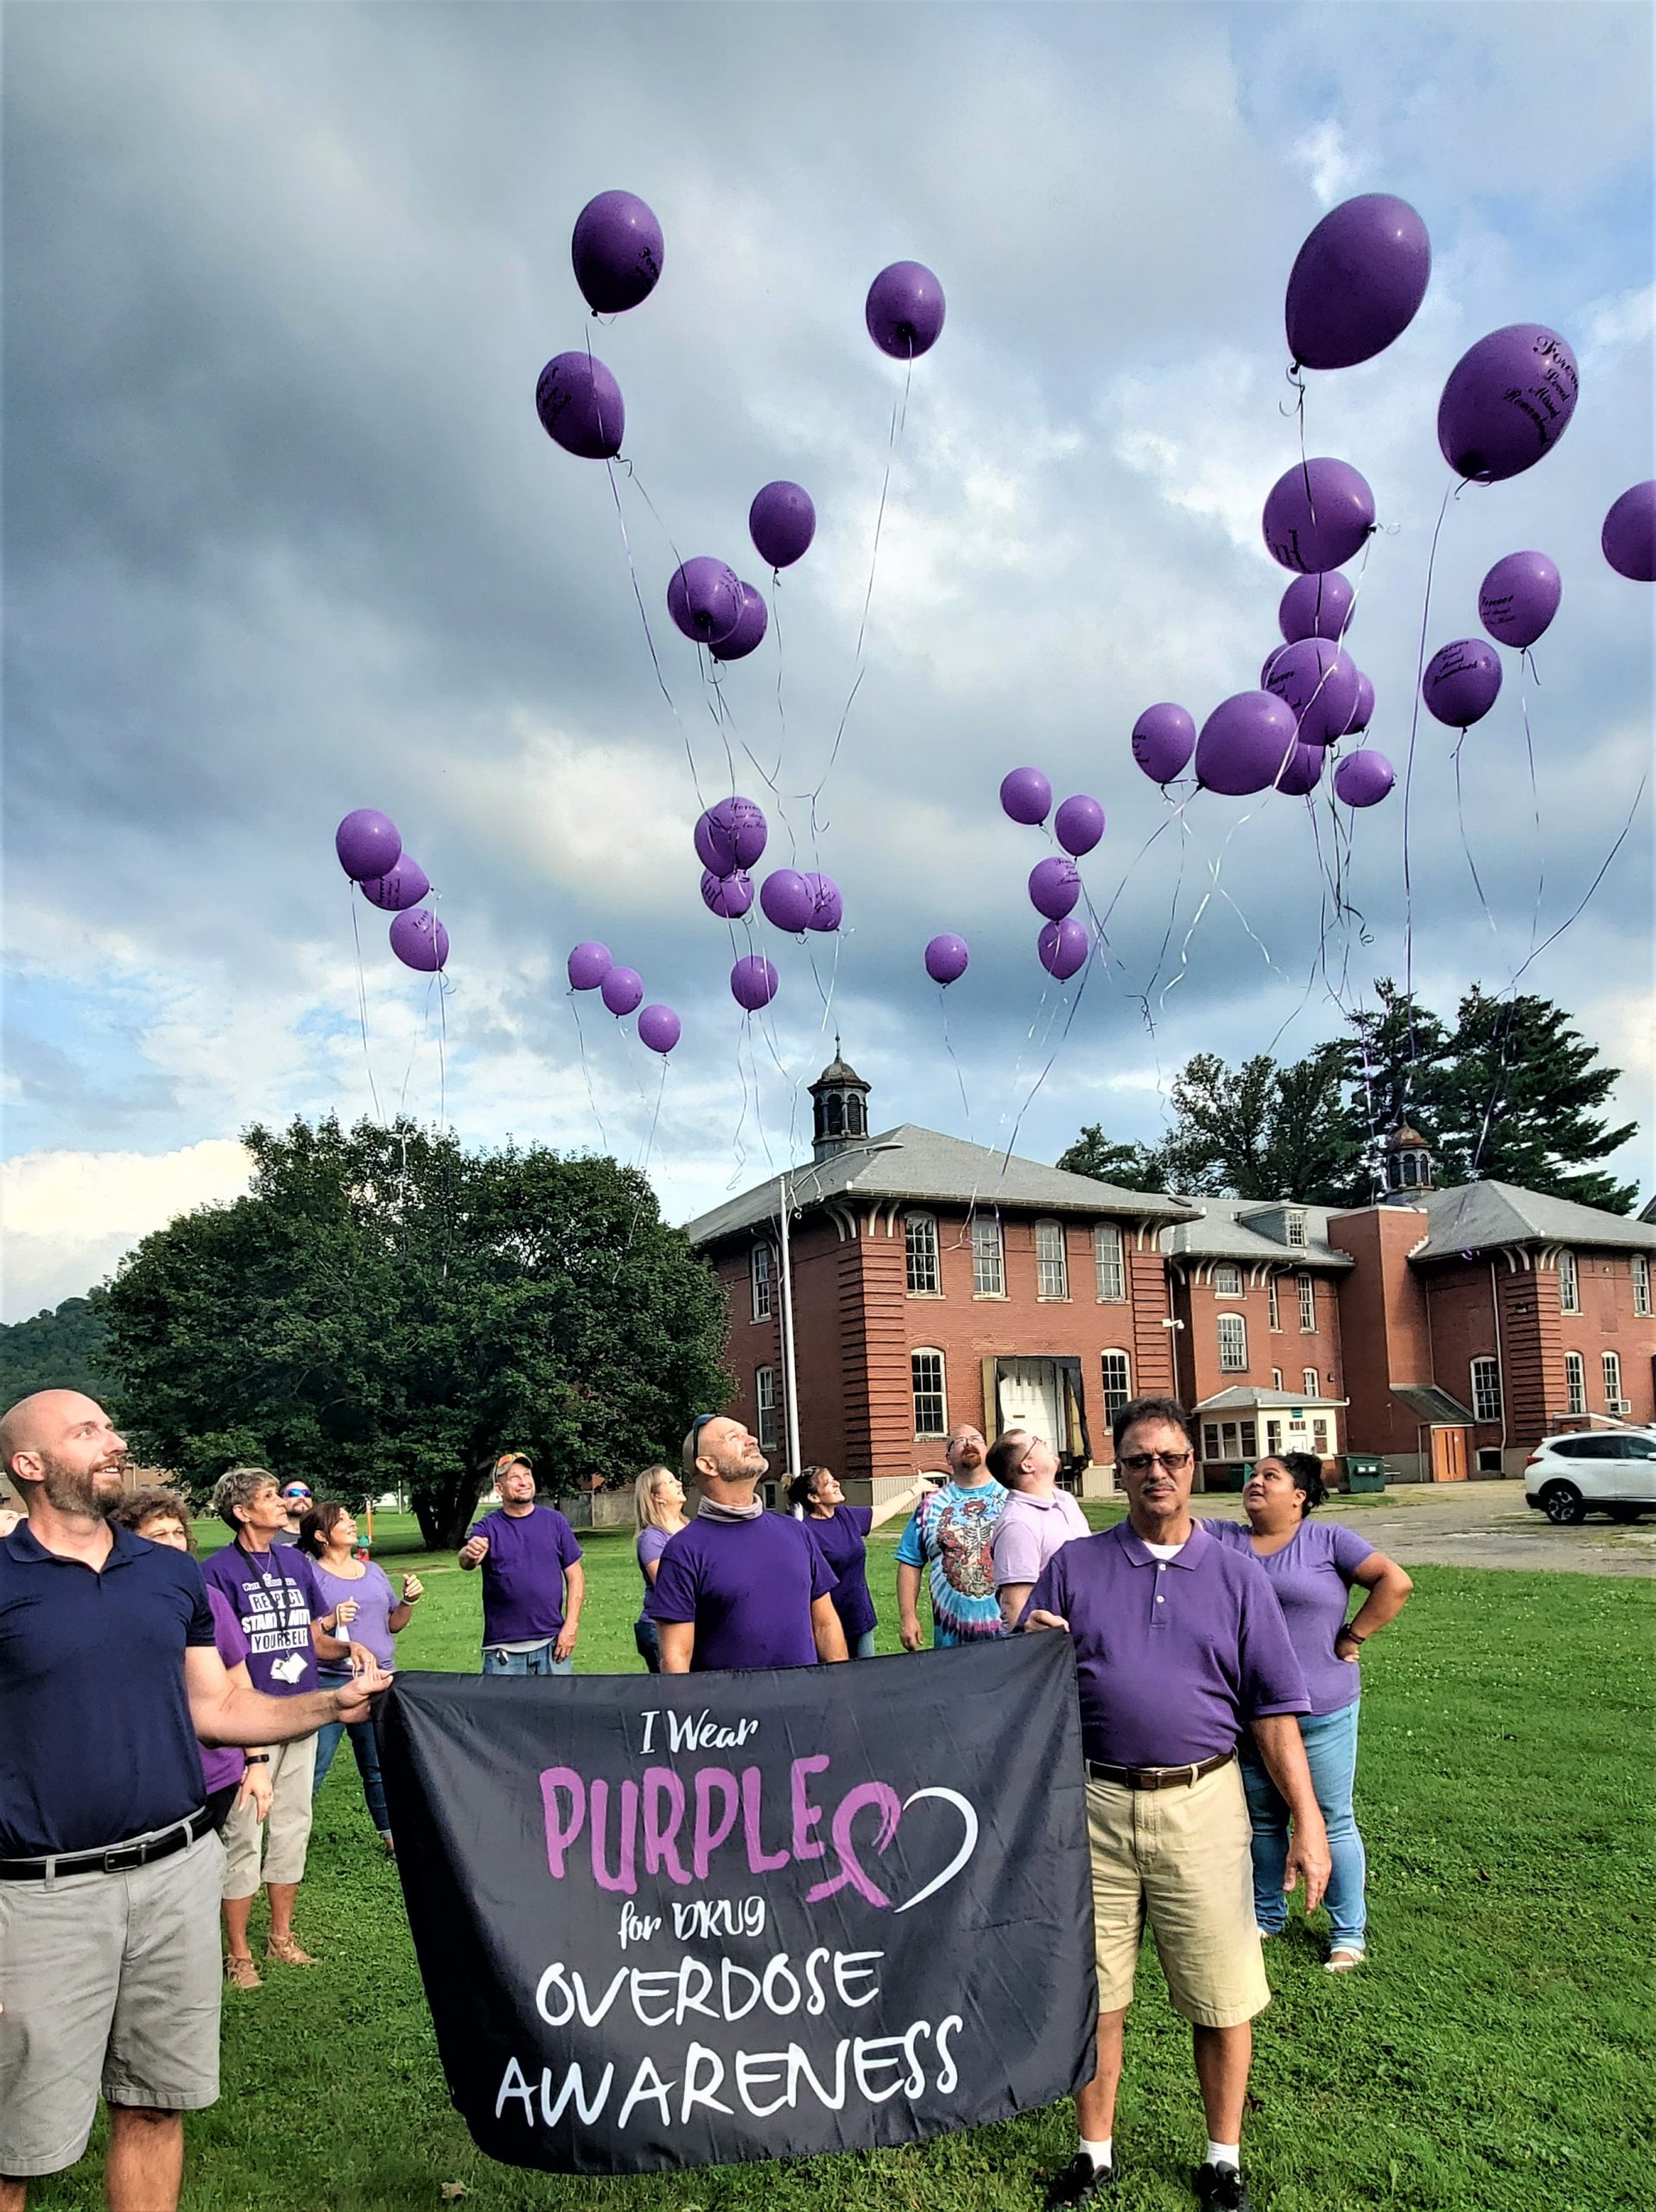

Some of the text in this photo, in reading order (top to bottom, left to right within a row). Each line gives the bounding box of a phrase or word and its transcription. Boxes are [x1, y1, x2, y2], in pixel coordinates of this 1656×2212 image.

[251, 1591, 302, 1611] REPCT
[253, 1629, 307, 1651] YOURSELF
[639, 1707, 759, 1755] I Wear
[537, 1754, 831, 1896] PURPLE
[617, 1895, 766, 1951] for DRUG
[534, 1947, 886, 2028] OVERDOSE
[494, 2013, 965, 2129] AWARENESS
